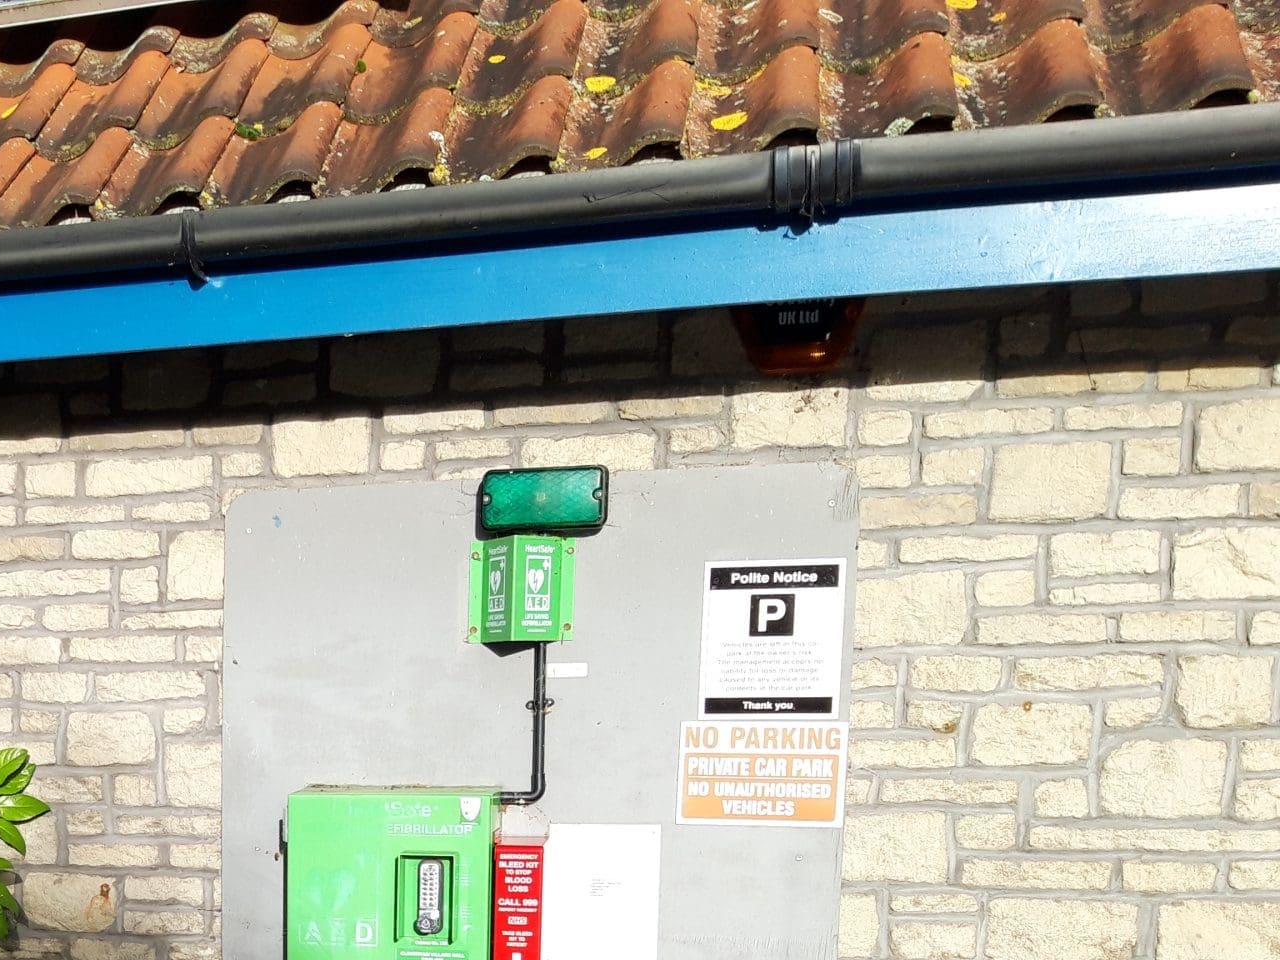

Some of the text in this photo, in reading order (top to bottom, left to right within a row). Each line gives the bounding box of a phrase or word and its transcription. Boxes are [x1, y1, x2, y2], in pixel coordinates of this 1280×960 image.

[779, 310, 819, 325] UK Ltd
[525, 543, 555, 554] HeartSafe
[731, 570, 818, 585] Polite Notice
[489, 598, 503, 609] AED
[526, 597, 548, 609] AED
[757, 598, 787, 632] P
[742, 701, 773, 710] Thank
[685, 726, 841, 750] NO PARKING
[687, 756, 833, 778] PRIVATE CAR PARK
[687, 781, 831, 799] NO UNAUTHORISED
[722, 800, 795, 816] VEHICLES
[498, 860, 539, 869] BLEED KIT
[504, 876, 532, 884] BLOOD
[508, 885, 529, 893] LOSS
[498, 898, 538, 907] CALL 999
